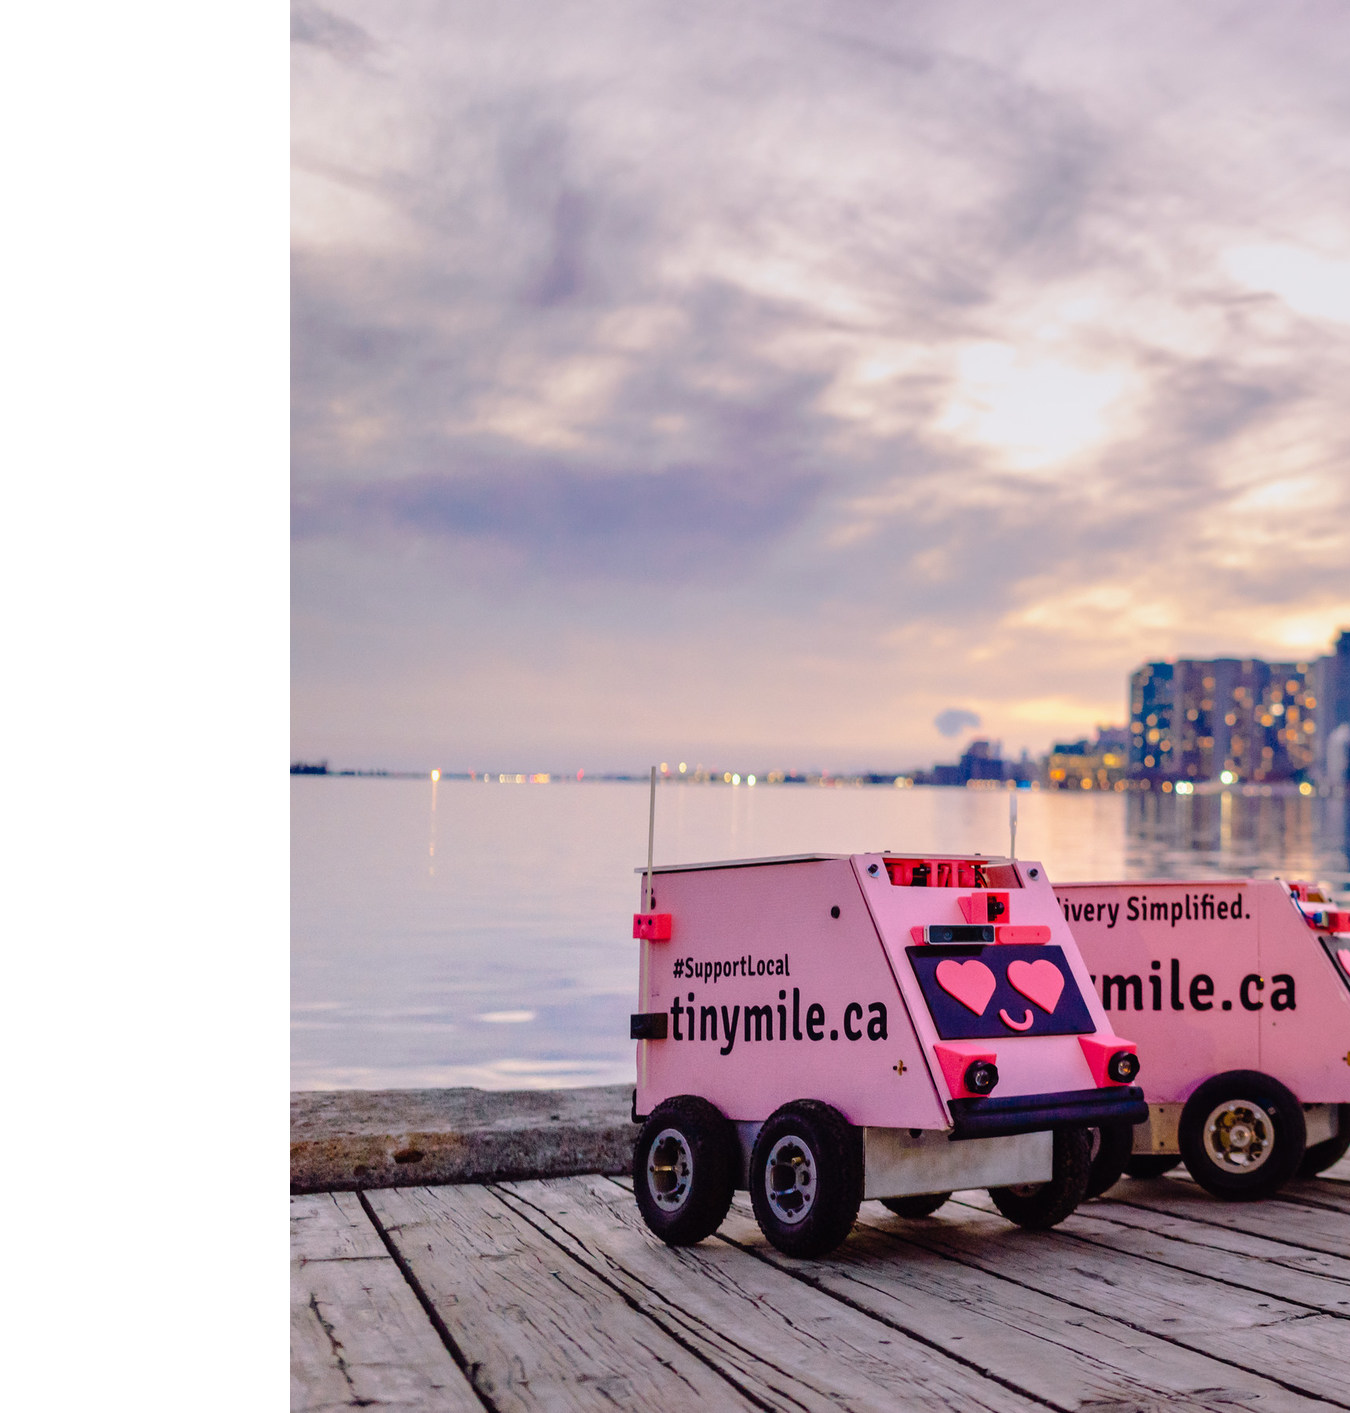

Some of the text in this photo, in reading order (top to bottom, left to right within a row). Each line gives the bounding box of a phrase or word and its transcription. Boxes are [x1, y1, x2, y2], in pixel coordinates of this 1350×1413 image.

[1057, 893, 1251, 928] ivery Simplified.
[673, 953, 790, 983] #SupportLocal
[1090, 958, 1296, 1011] mile.ca
[670, 987, 888, 1056] tinymile.ca
